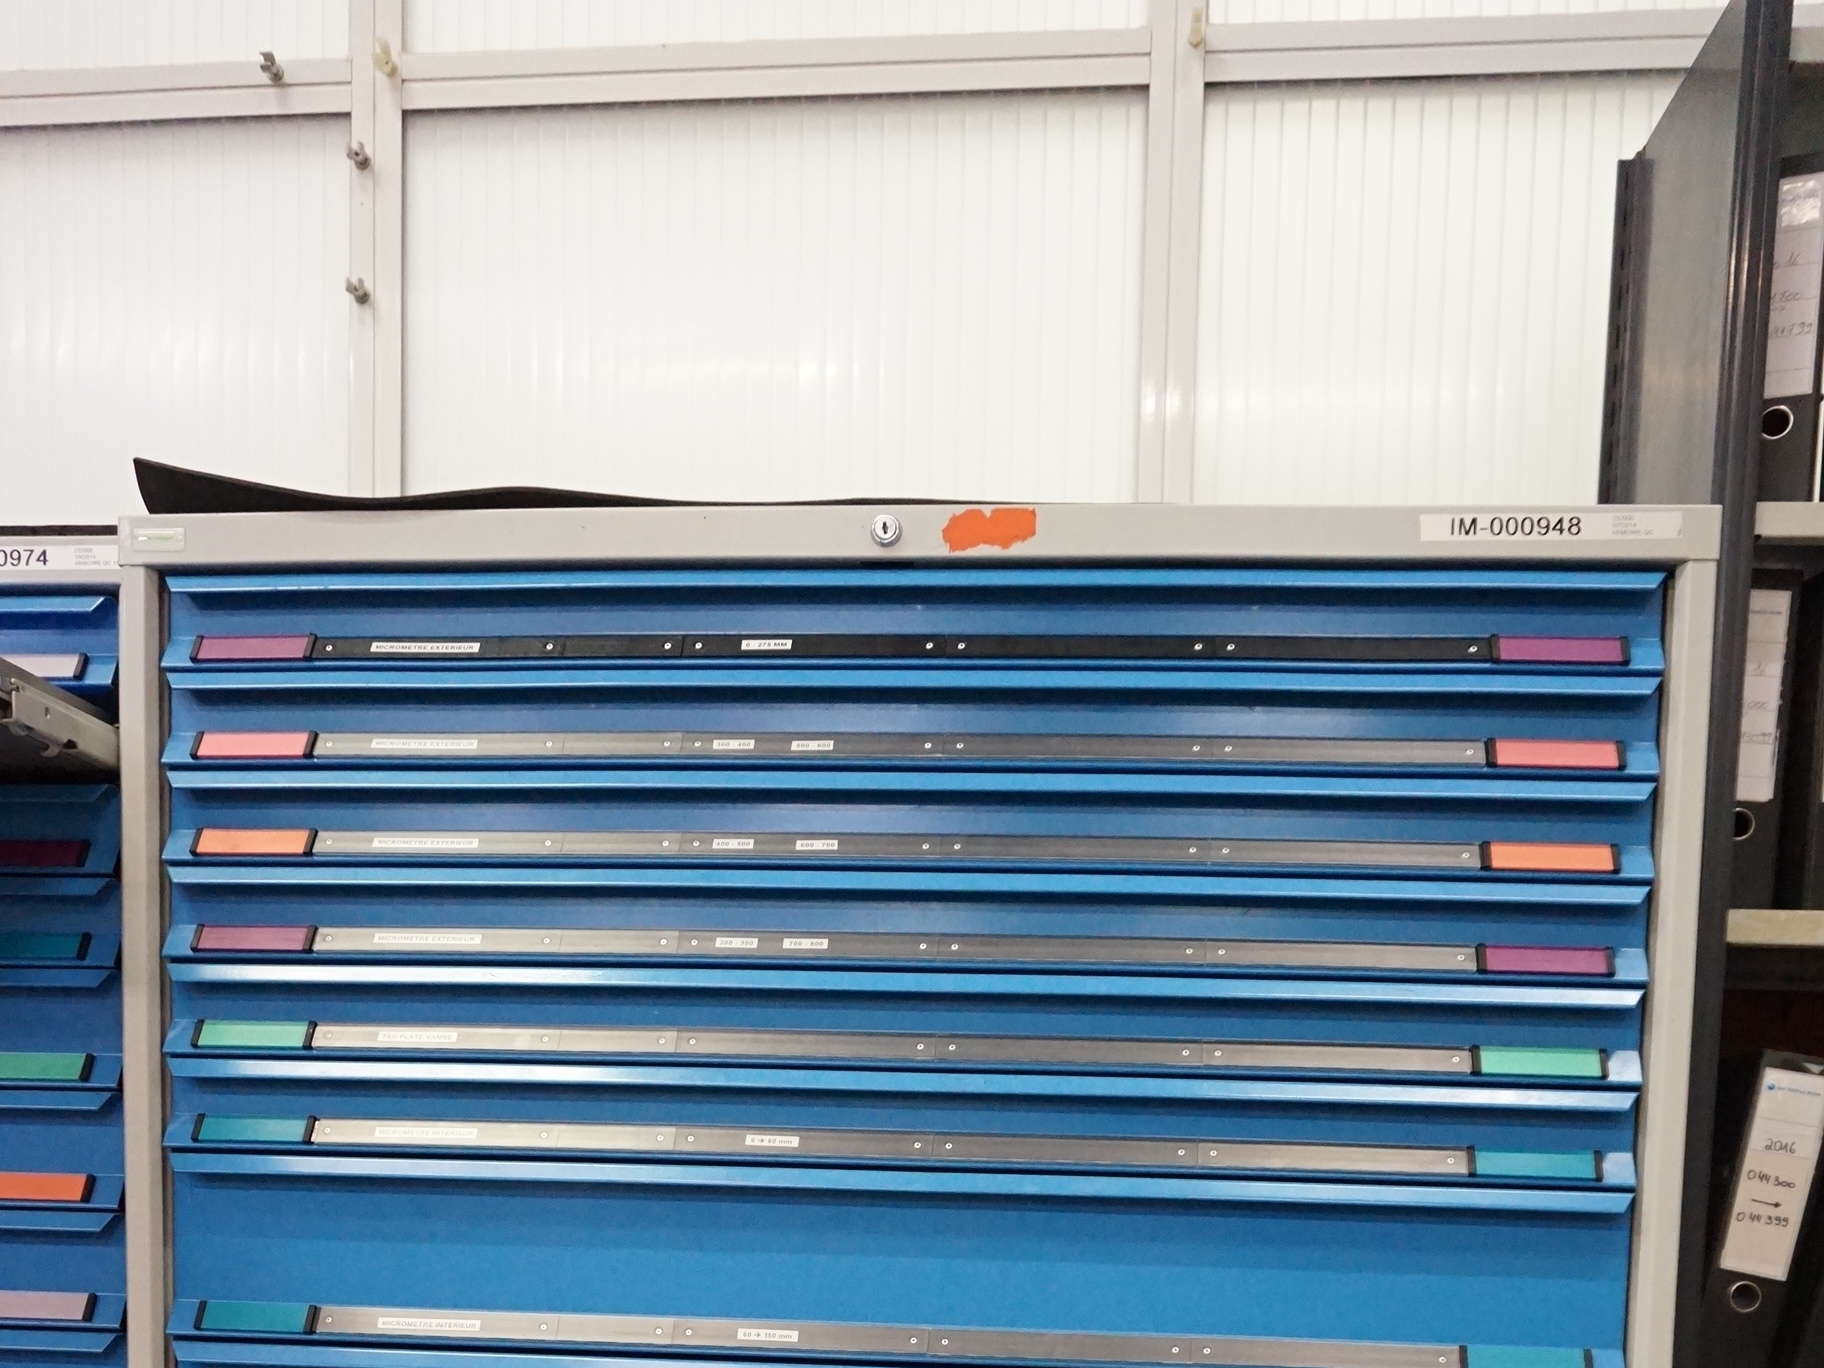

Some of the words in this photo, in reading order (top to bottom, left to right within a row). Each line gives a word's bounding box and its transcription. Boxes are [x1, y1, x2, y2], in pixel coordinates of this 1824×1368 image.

[1450, 516, 1582, 536] IM-000948
[0, 549, 49, 567] 0974
[1764, 1137, 1796, 1154] 2016
[1747, 1169, 1796, 1189] 044300
[1736, 1211, 1789, 1228] 044399
[381, 1320, 434, 1328] MICROMETRE
[434, 1321, 477, 1329] INTERIEUR
